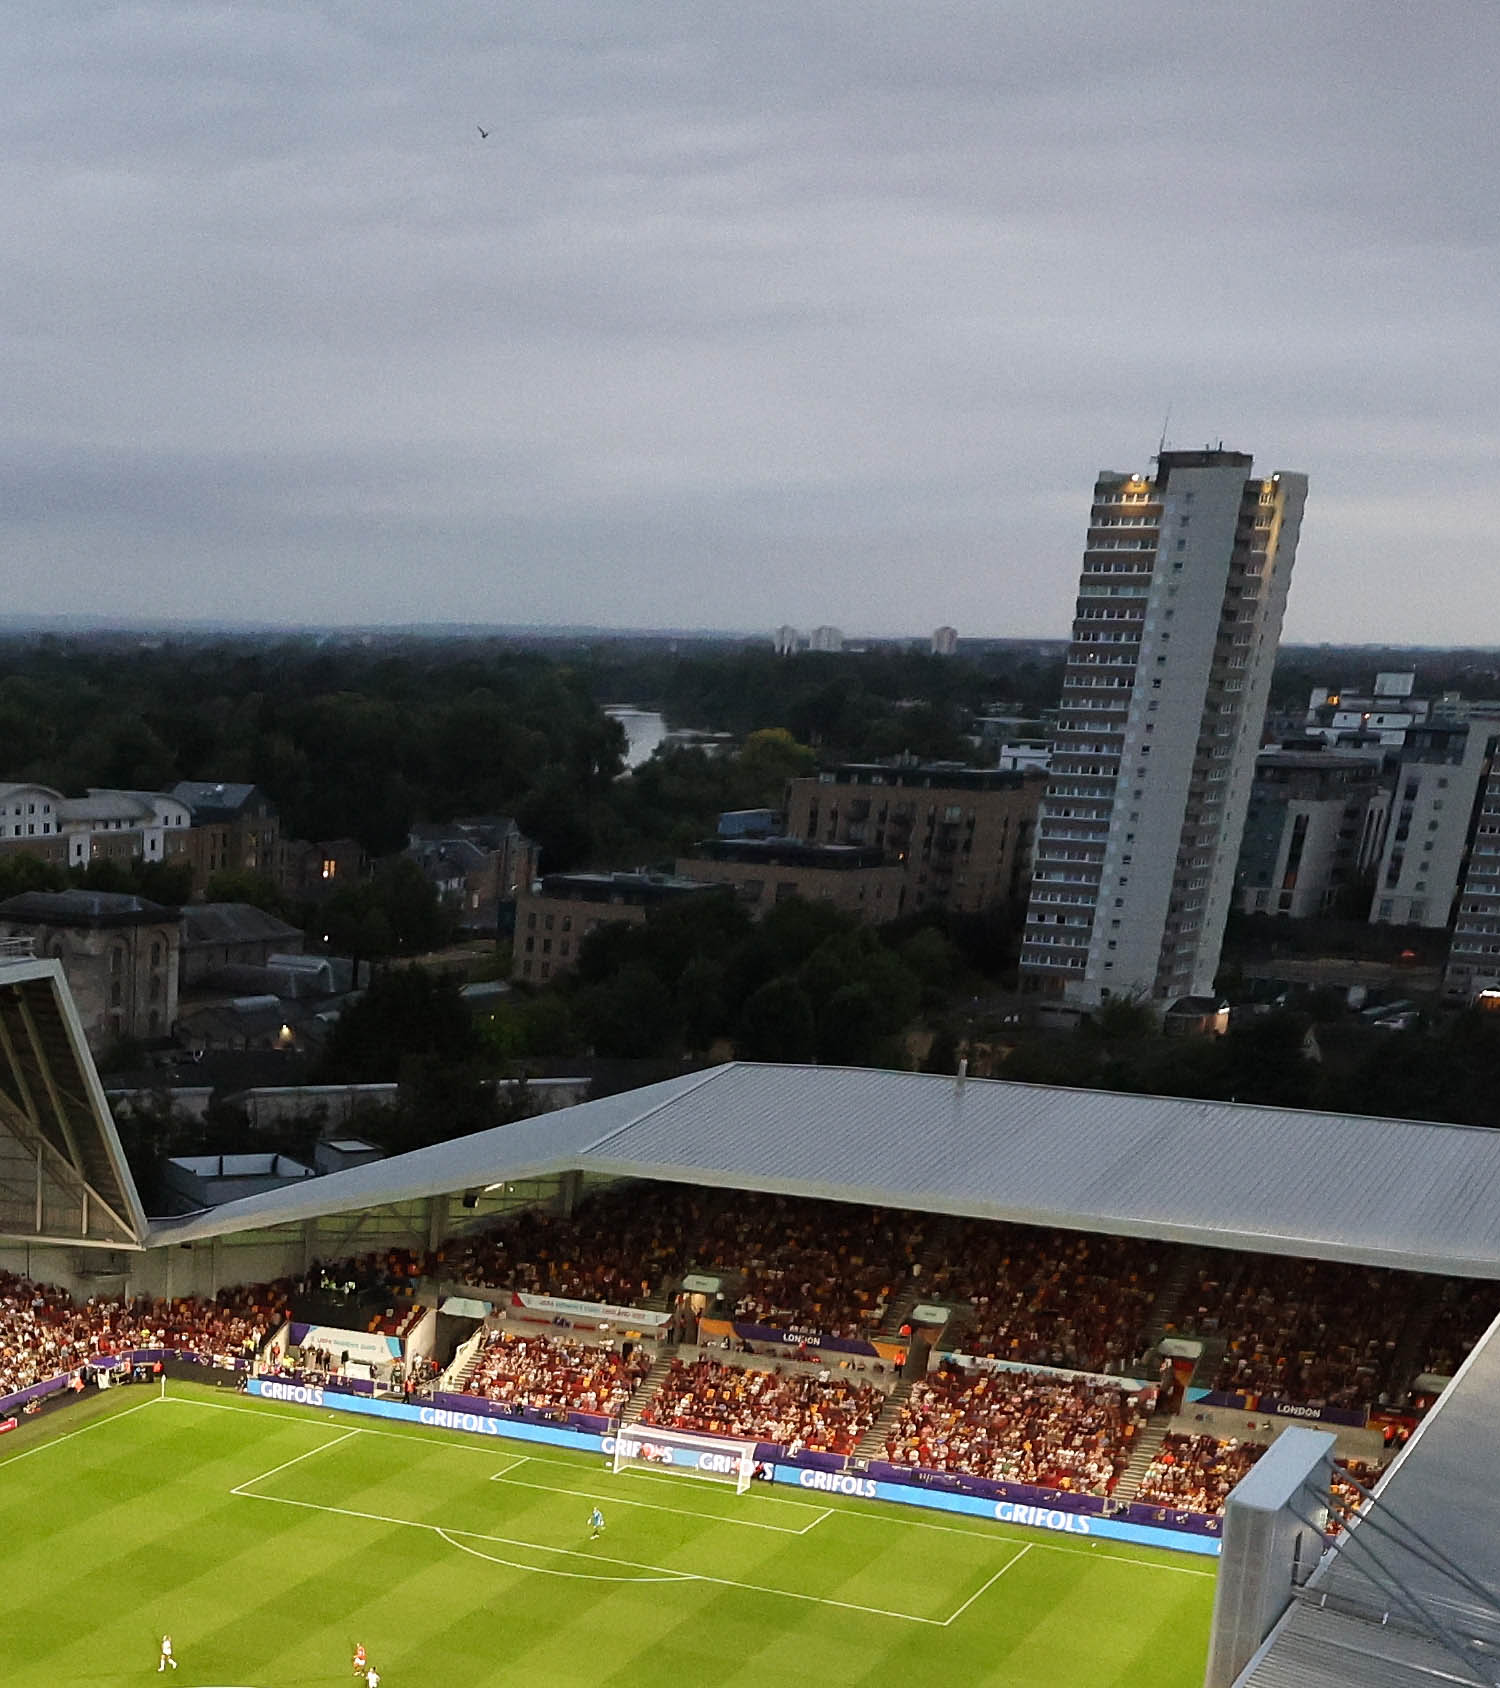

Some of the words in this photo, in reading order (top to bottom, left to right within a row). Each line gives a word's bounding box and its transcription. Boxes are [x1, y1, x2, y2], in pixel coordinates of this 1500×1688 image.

[260, 1380, 323, 1406] GRIFOLS
[420, 1406, 498, 1435] GRIFOLS
[1277, 1403, 1321, 1418] LONDON
[799, 1469, 877, 1498] GRIFOLS
[994, 1501, 1090, 1534] GRIFOLS
